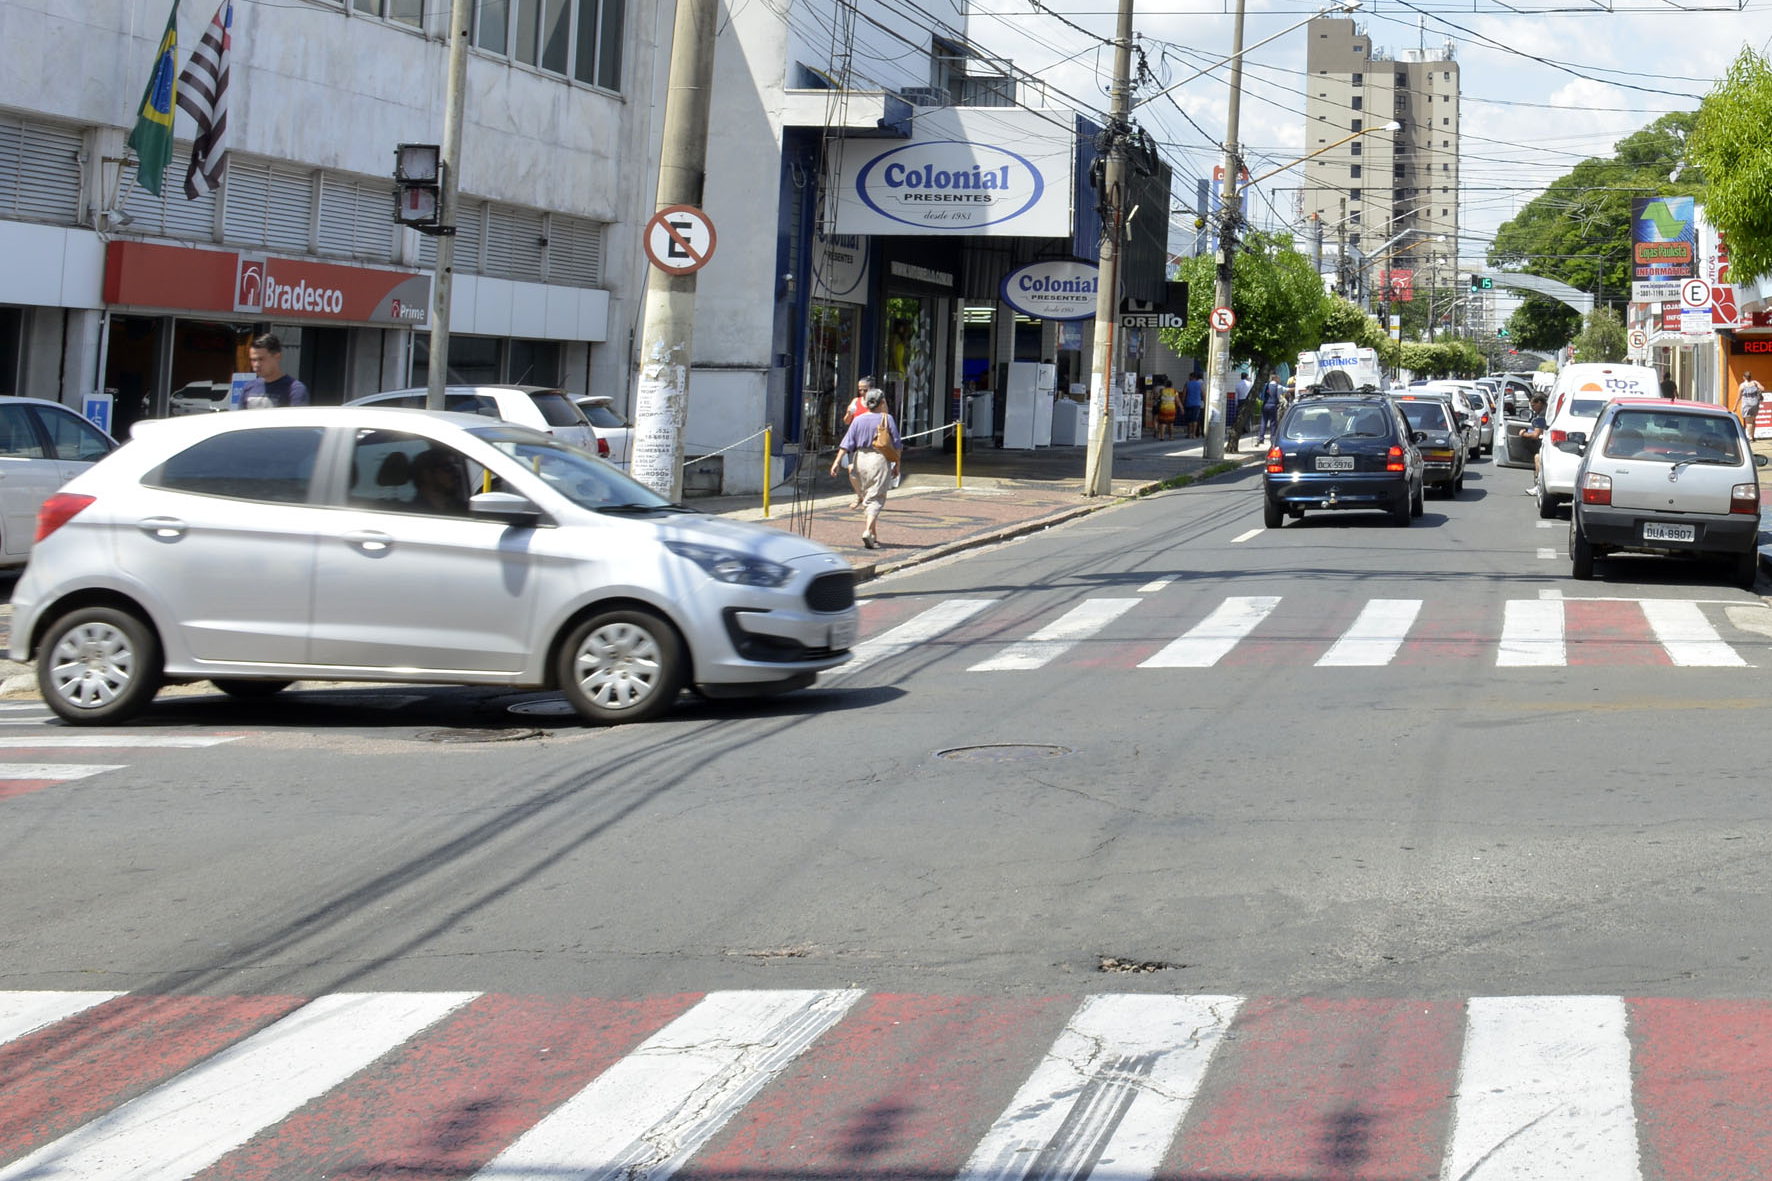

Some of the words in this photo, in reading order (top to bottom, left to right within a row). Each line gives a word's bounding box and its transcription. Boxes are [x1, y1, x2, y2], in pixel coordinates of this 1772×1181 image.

[884, 163, 1010, 190] Colonial
[904, 193, 992, 202] PRESENTES
[924, 209, 949, 220] desde
[1639, 244, 1658, 260] Lojas
[1658, 244, 1687, 257] Paulista
[1019, 274, 1098, 293] Colonial
[1482, 278, 1492, 289] 15
[265, 276, 343, 313] Bradesco
[1692, 286, 1702, 301] E
[400, 304, 425, 320] Prime
[1646, 527, 1692, 540] DUA-8907
